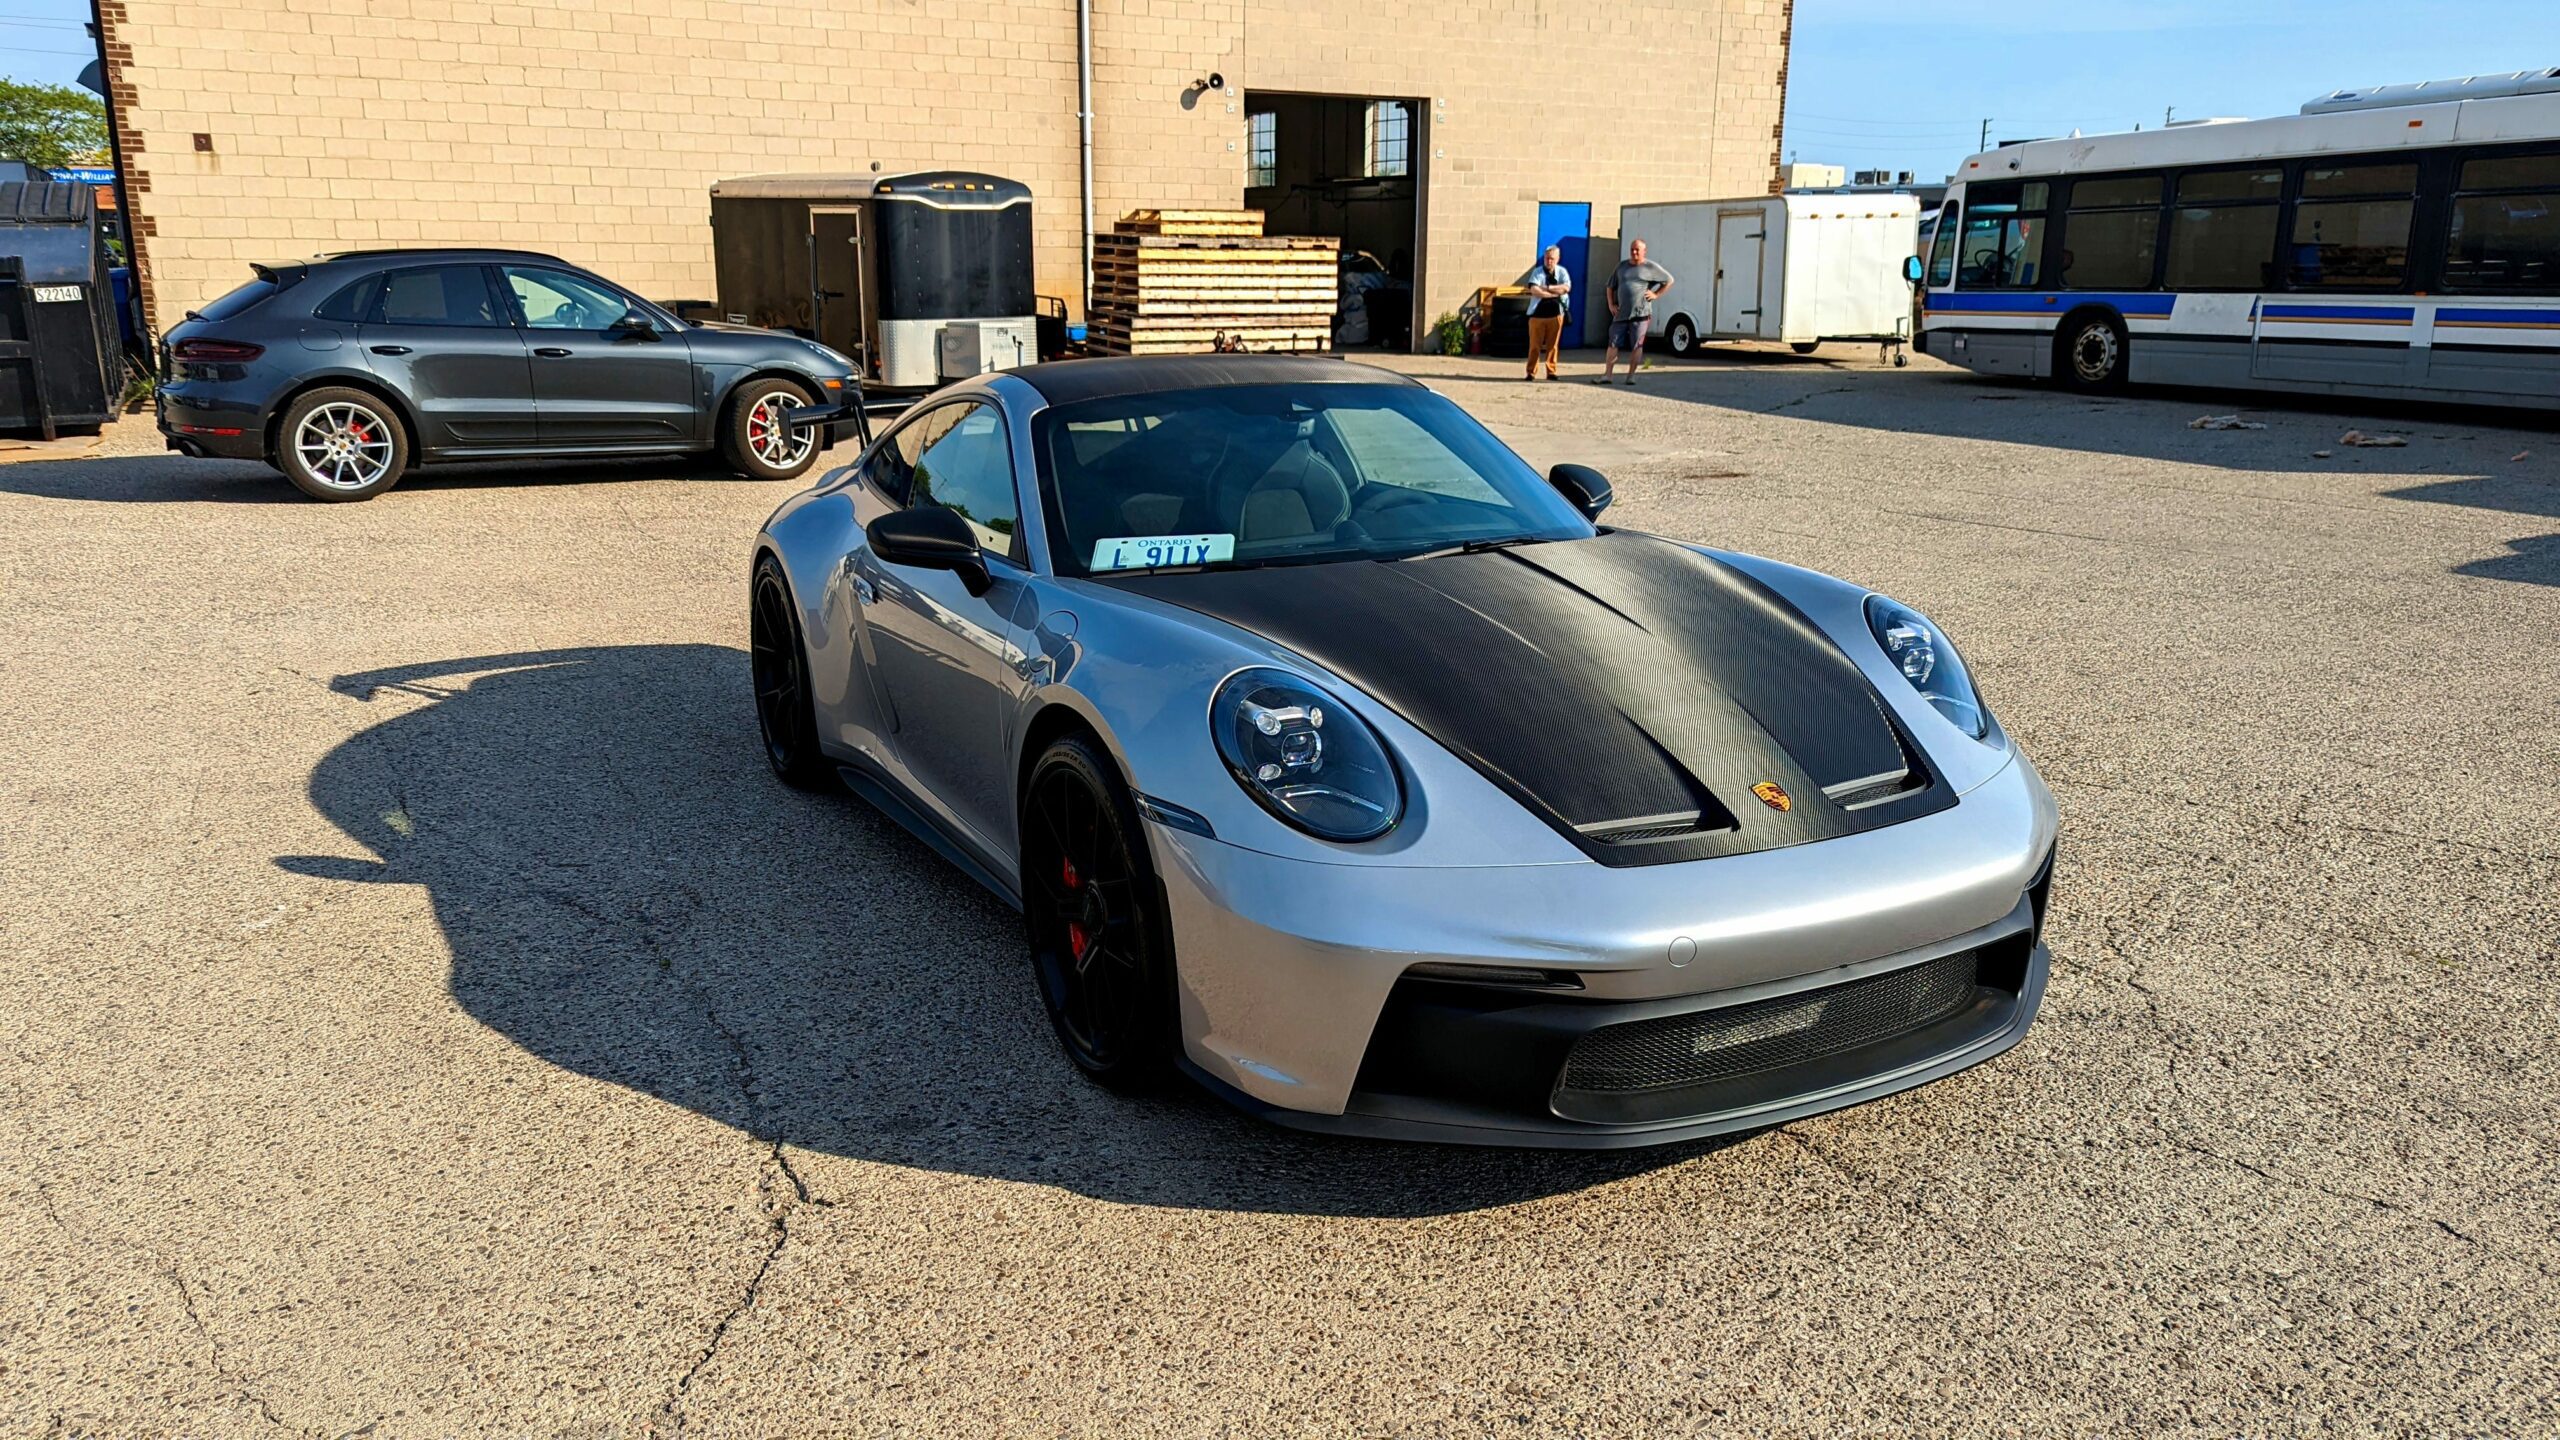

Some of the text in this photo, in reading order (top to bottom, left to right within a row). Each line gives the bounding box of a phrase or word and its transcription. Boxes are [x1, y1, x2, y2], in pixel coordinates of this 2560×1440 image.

[37, 287, 79, 301] S22140
[1138, 539, 1192, 547] ONTARIO
[1113, 545, 1210, 568] L 911X
